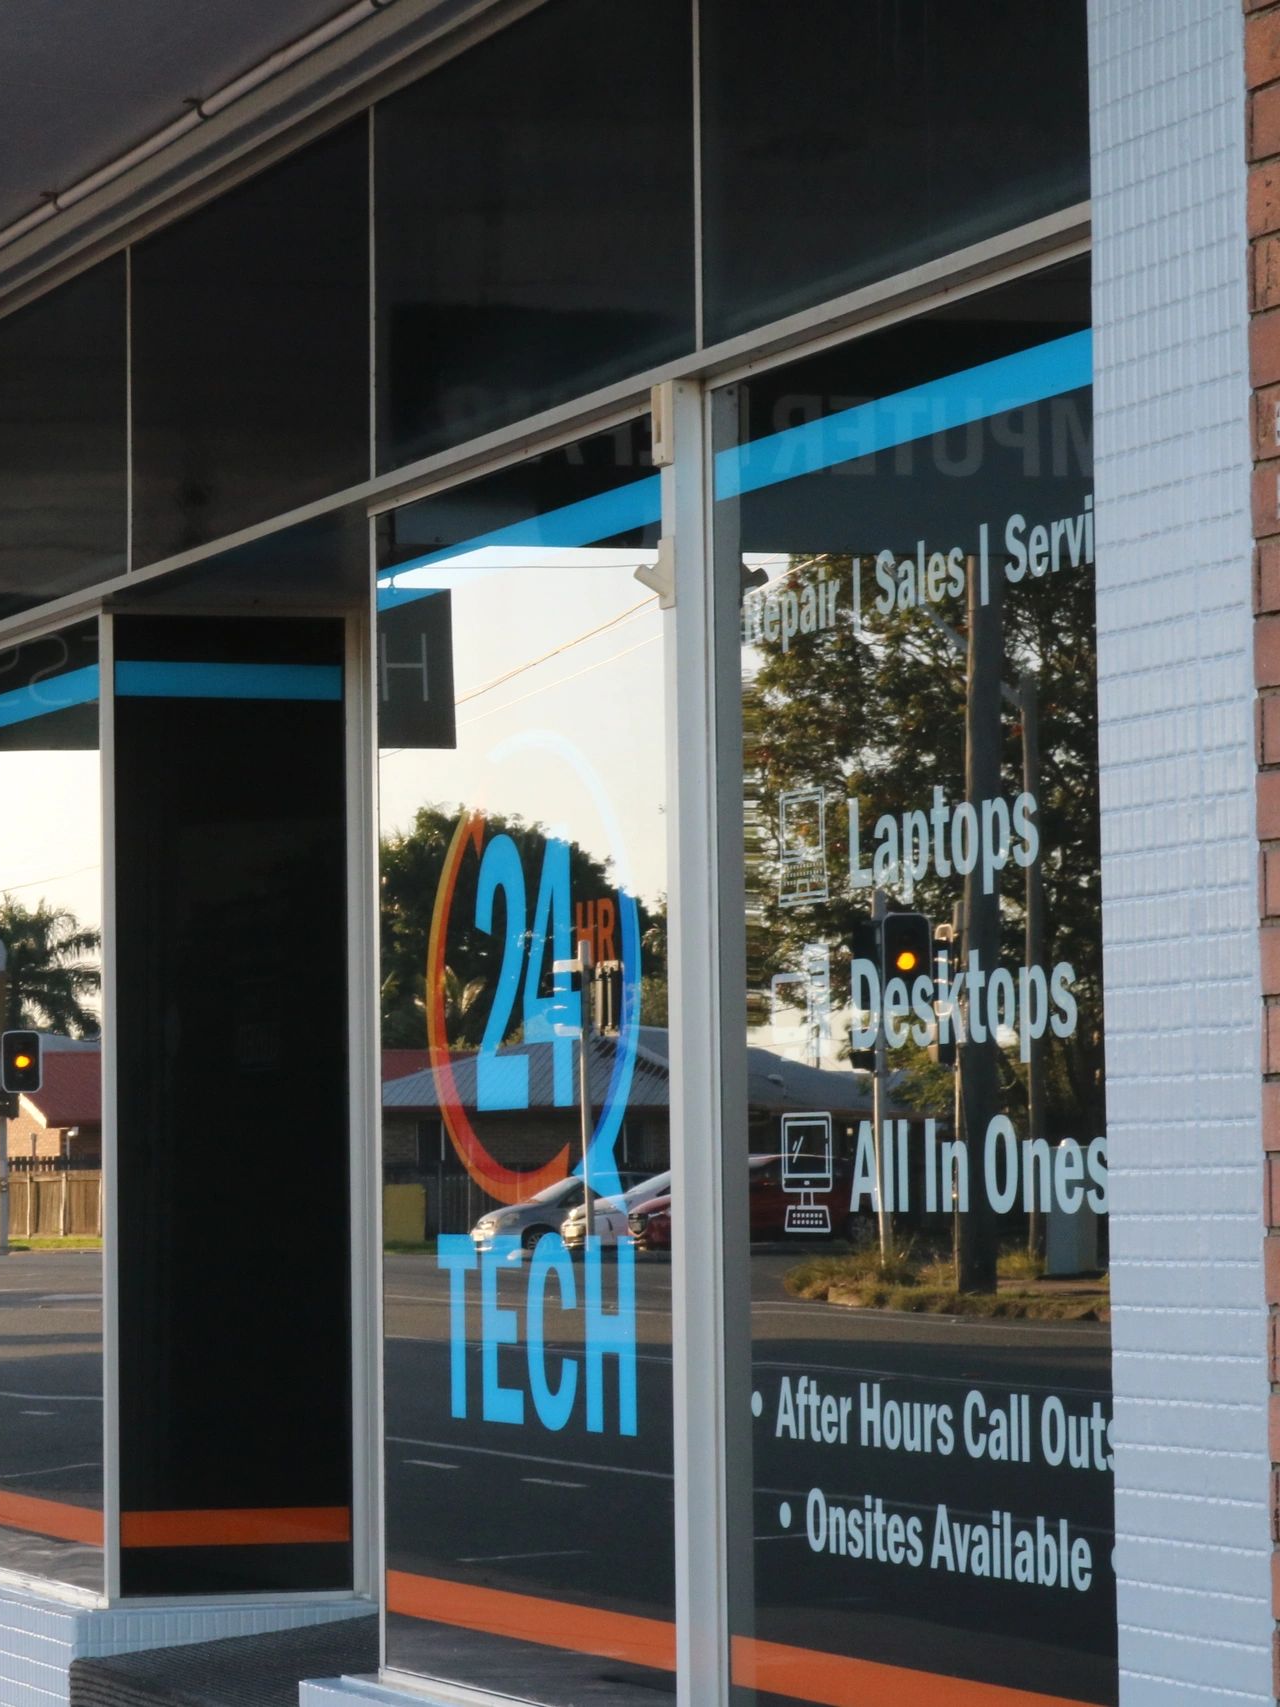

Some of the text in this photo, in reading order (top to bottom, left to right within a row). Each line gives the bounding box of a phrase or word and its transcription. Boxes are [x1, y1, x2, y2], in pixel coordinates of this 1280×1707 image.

[743, 494, 1094, 653] Repair Sales Servi
[848, 785, 1040, 905] Laptops
[851, 948, 1079, 1064] Desktops
[849, 1113, 1109, 1215] All In Ones
[437, 1232, 638, 1437] TECH
[775, 1375, 853, 1445] After
[859, 1382, 955, 1456] Hours
[963, 1389, 1031, 1463] Call
[806, 1487, 1093, 1592] Onsites Available
